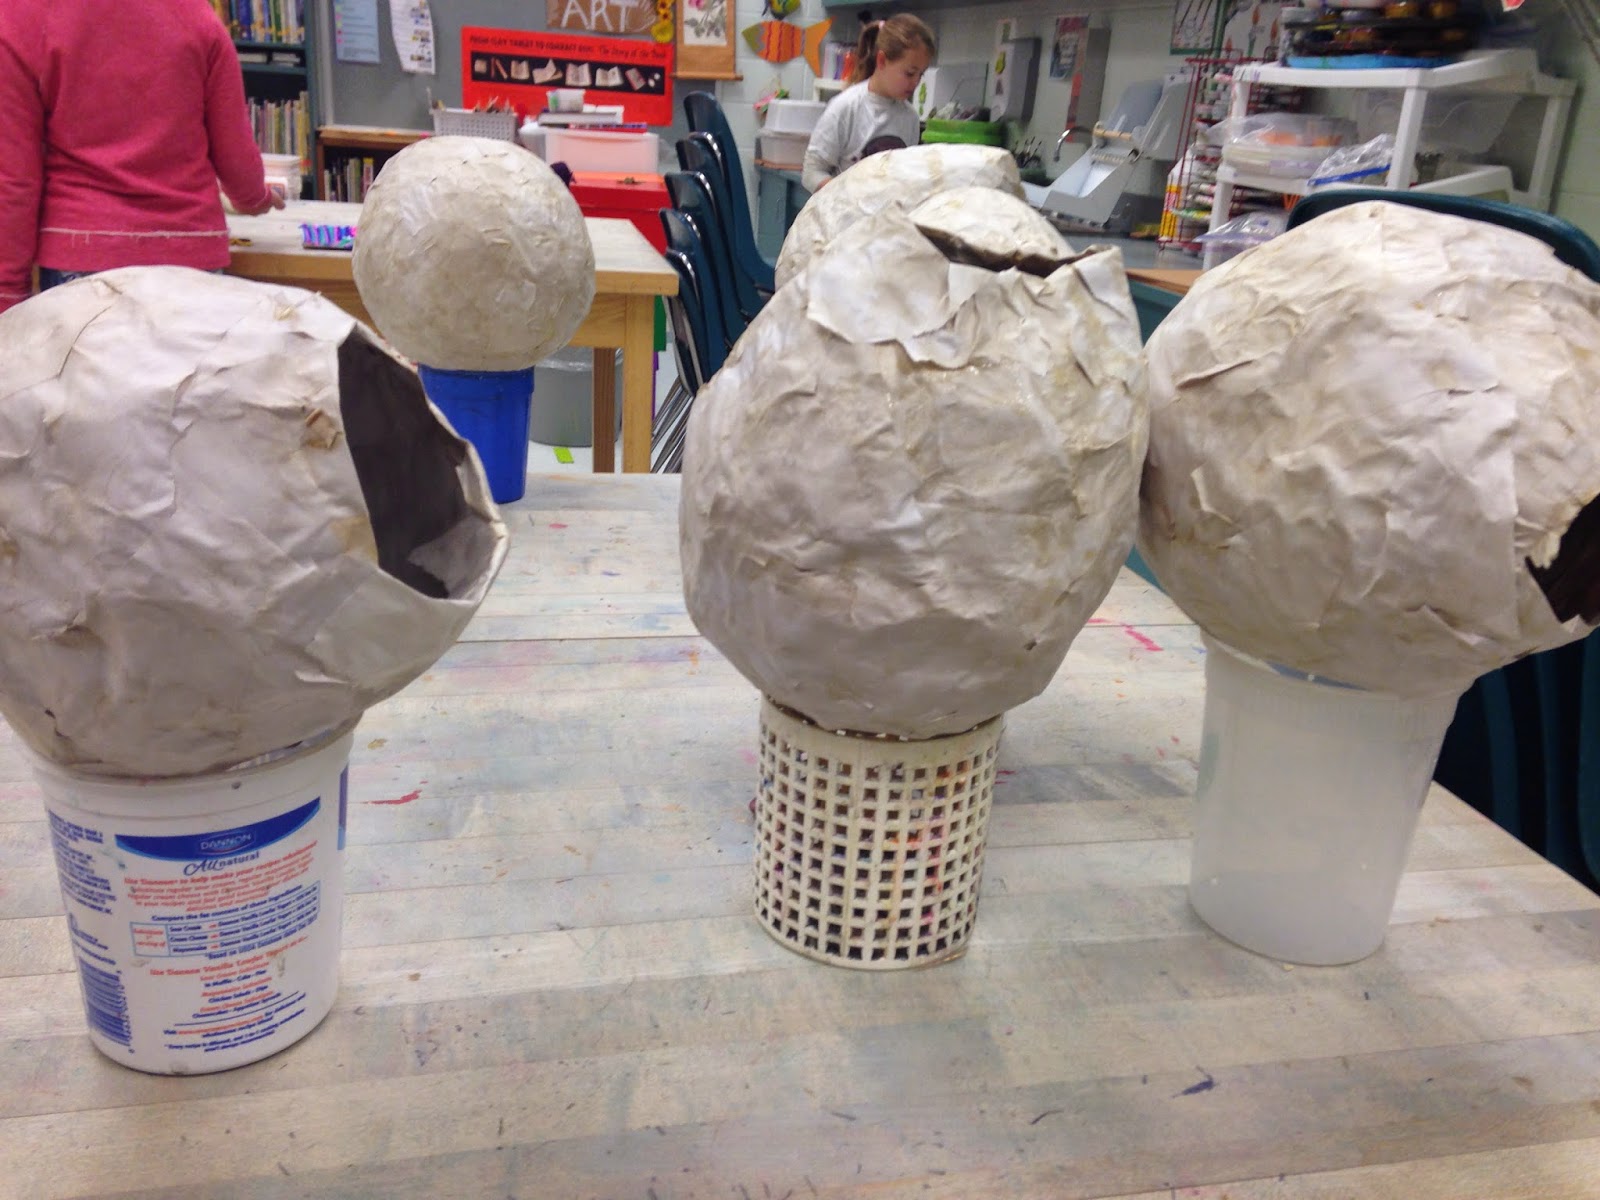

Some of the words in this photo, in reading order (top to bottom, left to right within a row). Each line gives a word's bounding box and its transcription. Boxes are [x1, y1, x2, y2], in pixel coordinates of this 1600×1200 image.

[561, 0, 639, 32] ART
[200, 833, 252, 850] DANNON
[183, 857, 223, 876] All
[219, 851, 259, 868] natural
